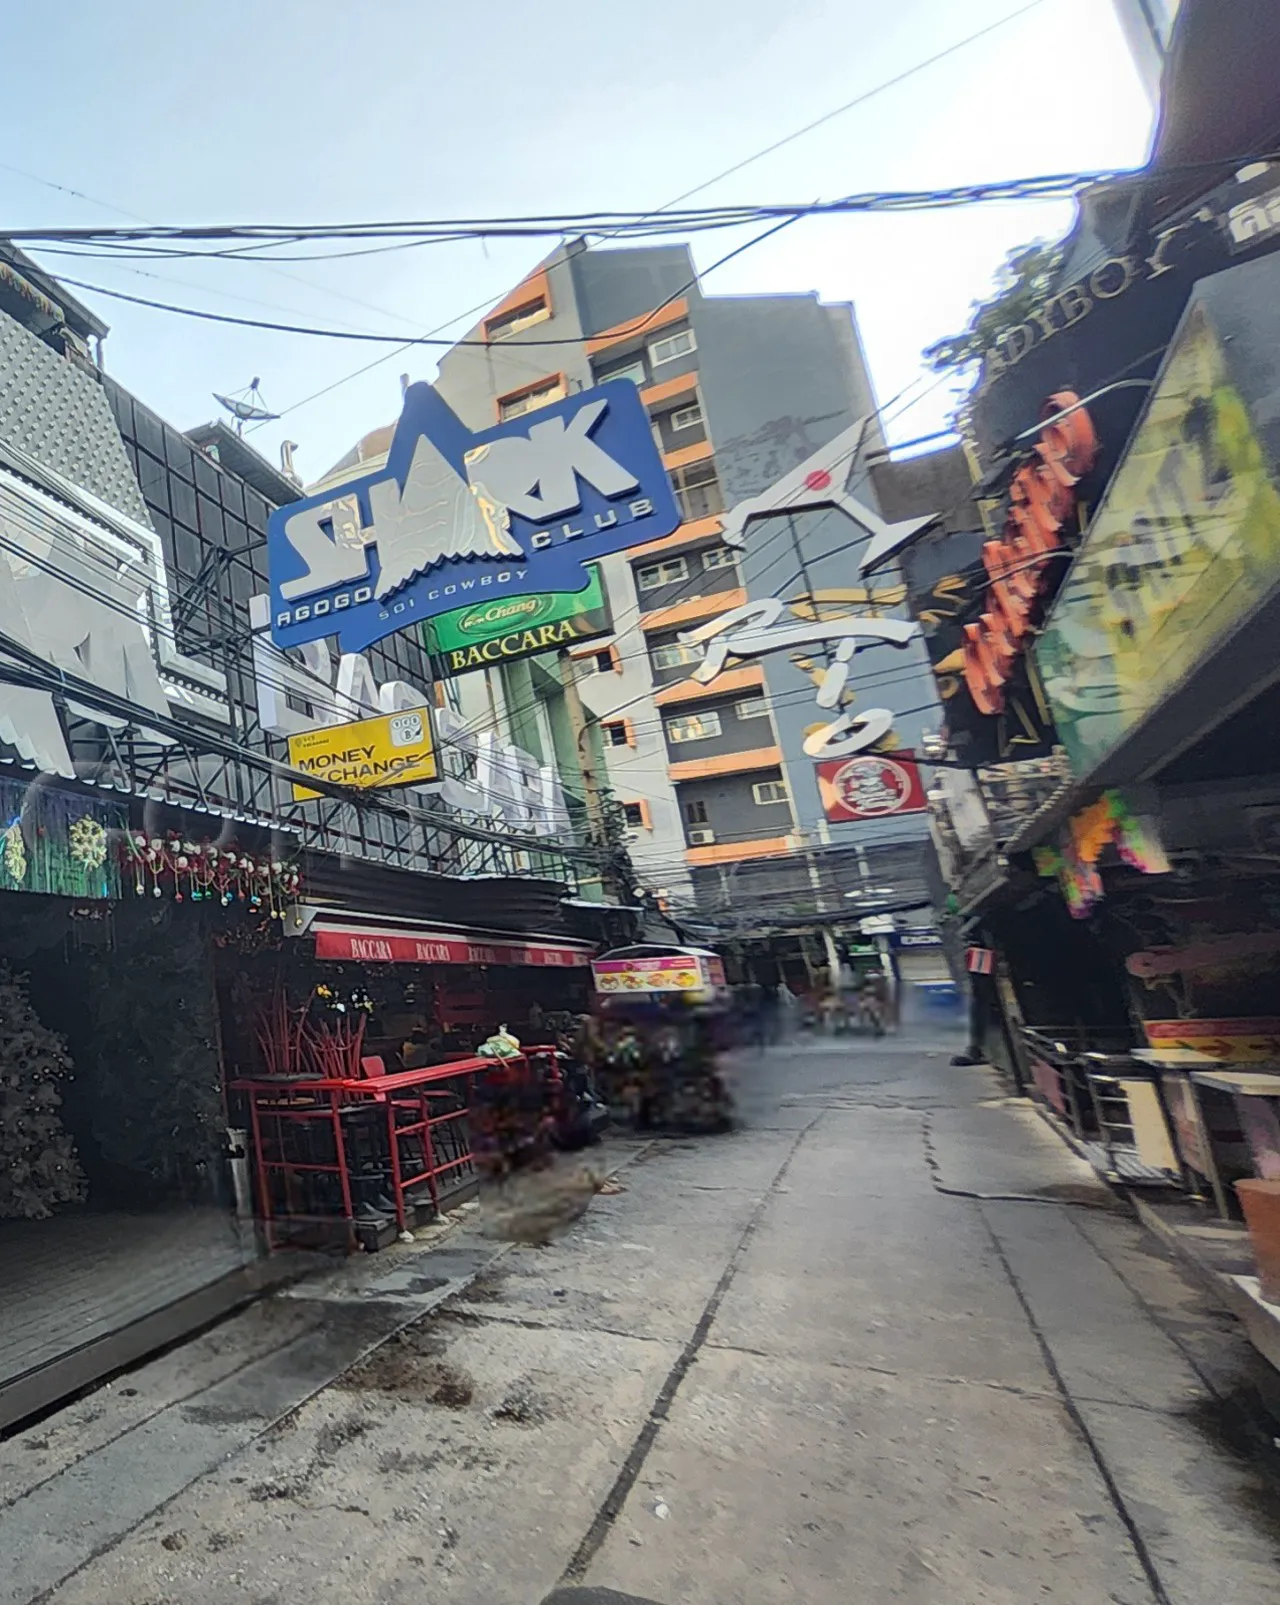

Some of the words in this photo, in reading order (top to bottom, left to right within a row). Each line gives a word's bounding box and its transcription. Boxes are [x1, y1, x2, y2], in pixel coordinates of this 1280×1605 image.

[280, 398, 640, 601] SHARK
[530, 499, 655, 552] CLUB
[276, 586, 373, 628] AGOGO
[377, 599, 416, 622] SOI
[428, 568, 530, 601] COWBOY
[485, 598, 537, 623] Chang
[450, 619, 579, 671] BACCARA
[298, 745, 376, 772] MONEY
[305, 754, 422, 783] CHANGE
[350, 937, 394, 960] BACCARA
